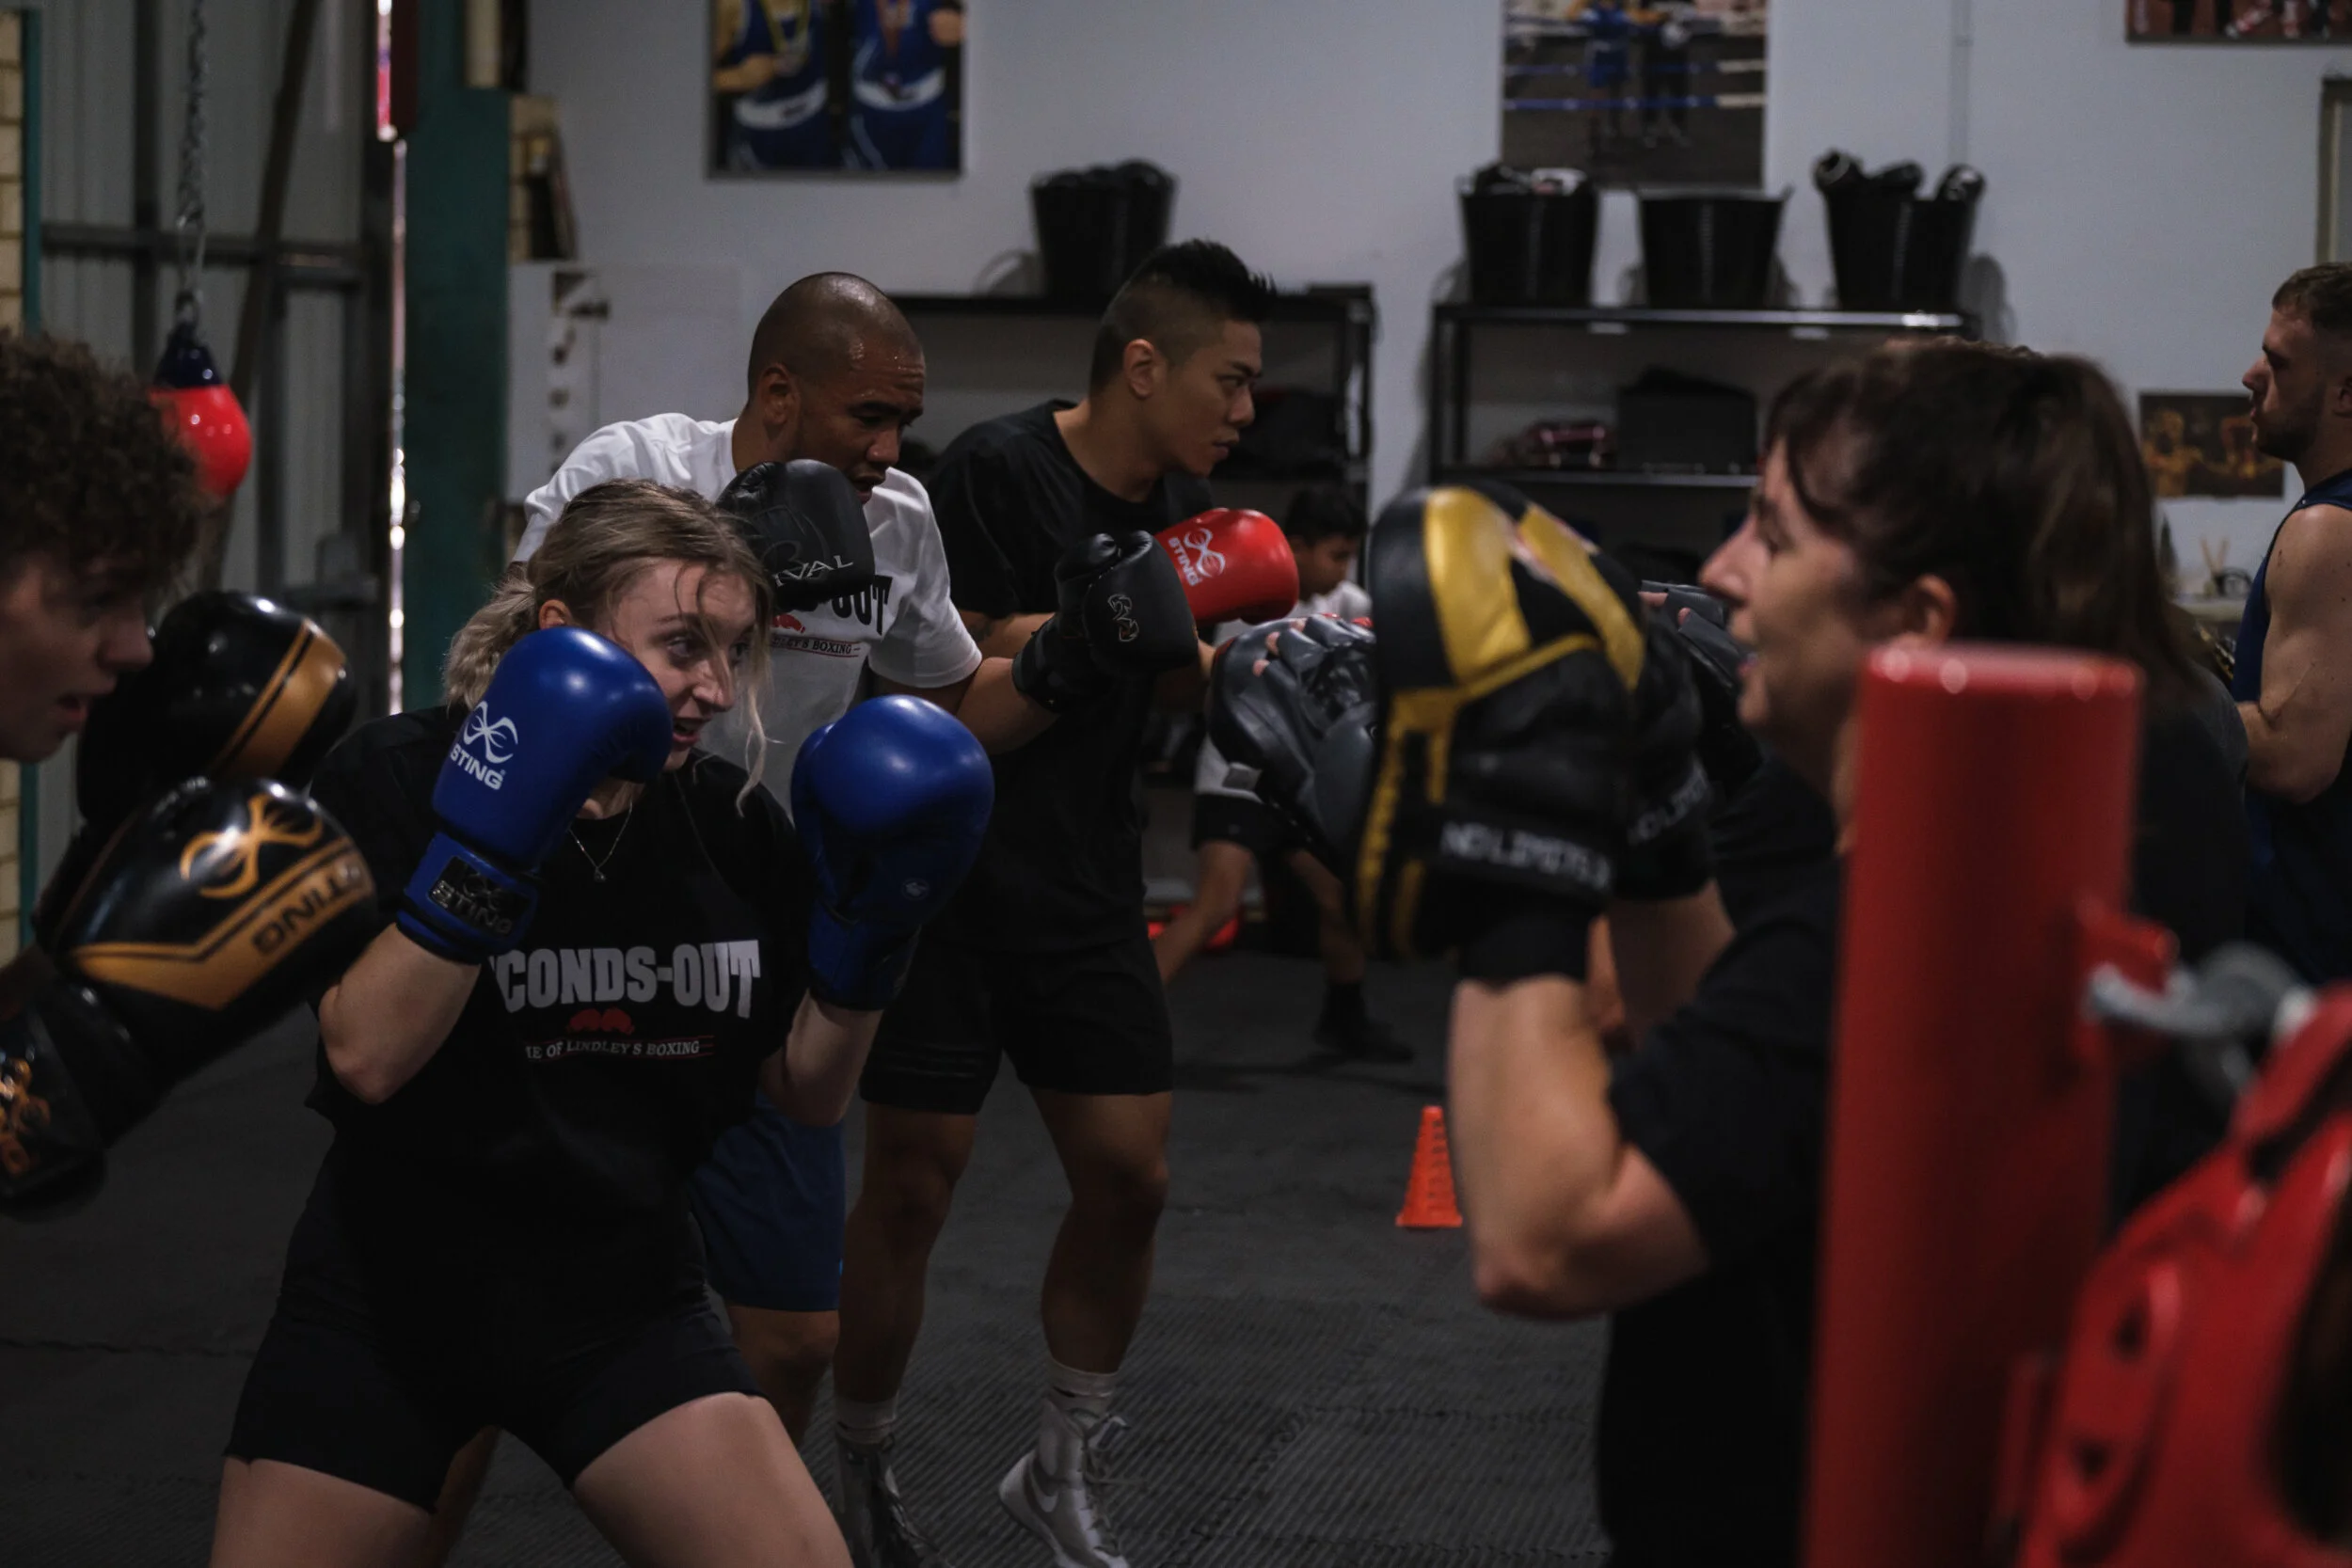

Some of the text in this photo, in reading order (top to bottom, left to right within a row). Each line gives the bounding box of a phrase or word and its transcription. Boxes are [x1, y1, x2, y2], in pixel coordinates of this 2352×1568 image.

[771, 555, 854, 588] IVAL
[1168, 536, 1200, 587] STING
[812, 639, 852, 655] BOXING
[450, 743, 504, 791] STING
[431, 879, 514, 936] STING
[487, 939, 762, 1020] CONDS-OUT
[546, 1040, 564, 1058] OF
[566, 1039, 644, 1055] LINDLEYS
[645, 1039, 701, 1056] BOXING
